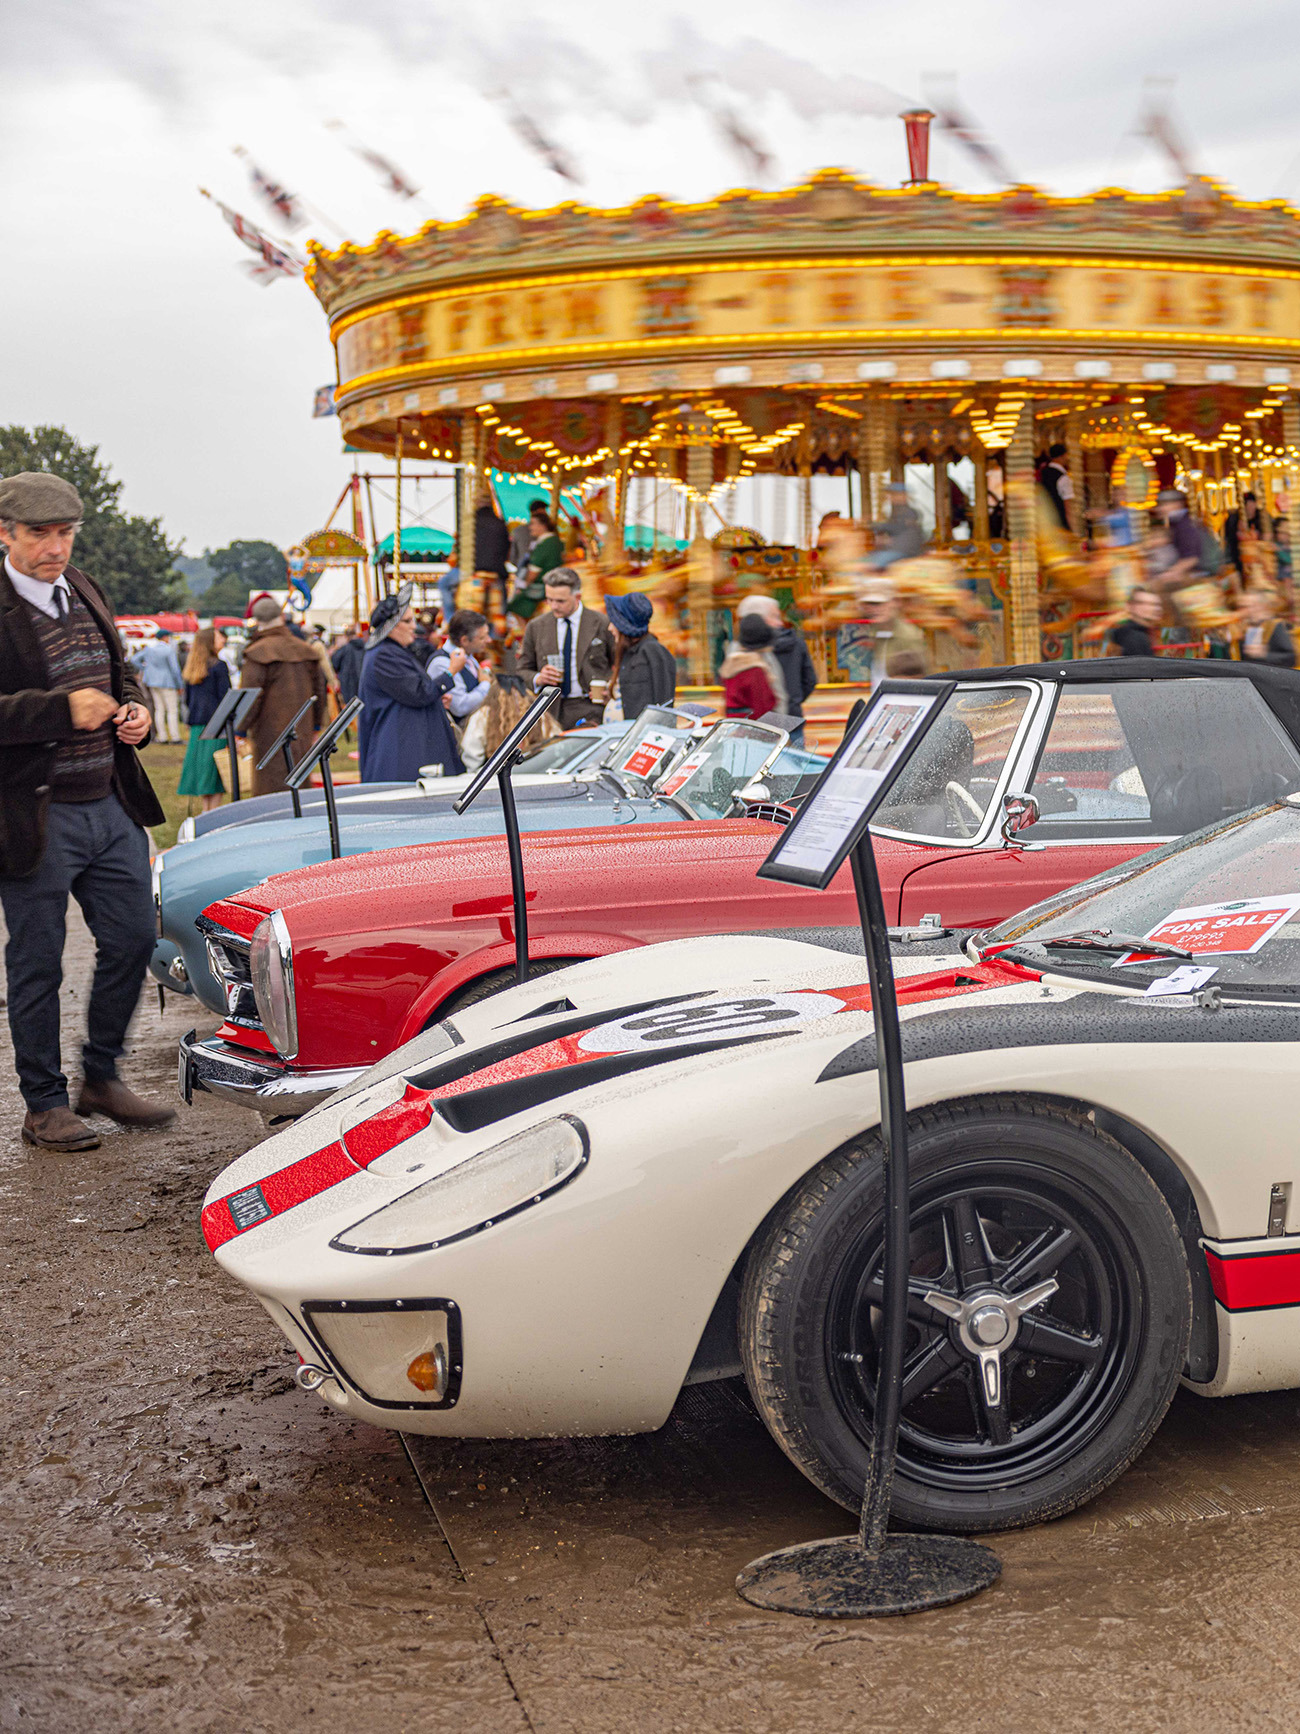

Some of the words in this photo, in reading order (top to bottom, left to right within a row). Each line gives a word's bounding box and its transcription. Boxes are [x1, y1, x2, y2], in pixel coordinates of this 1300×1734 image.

[1154, 920, 1205, 937] FOR
[1211, 912, 1282, 930] SALE
[621, 998, 800, 1041] 60
